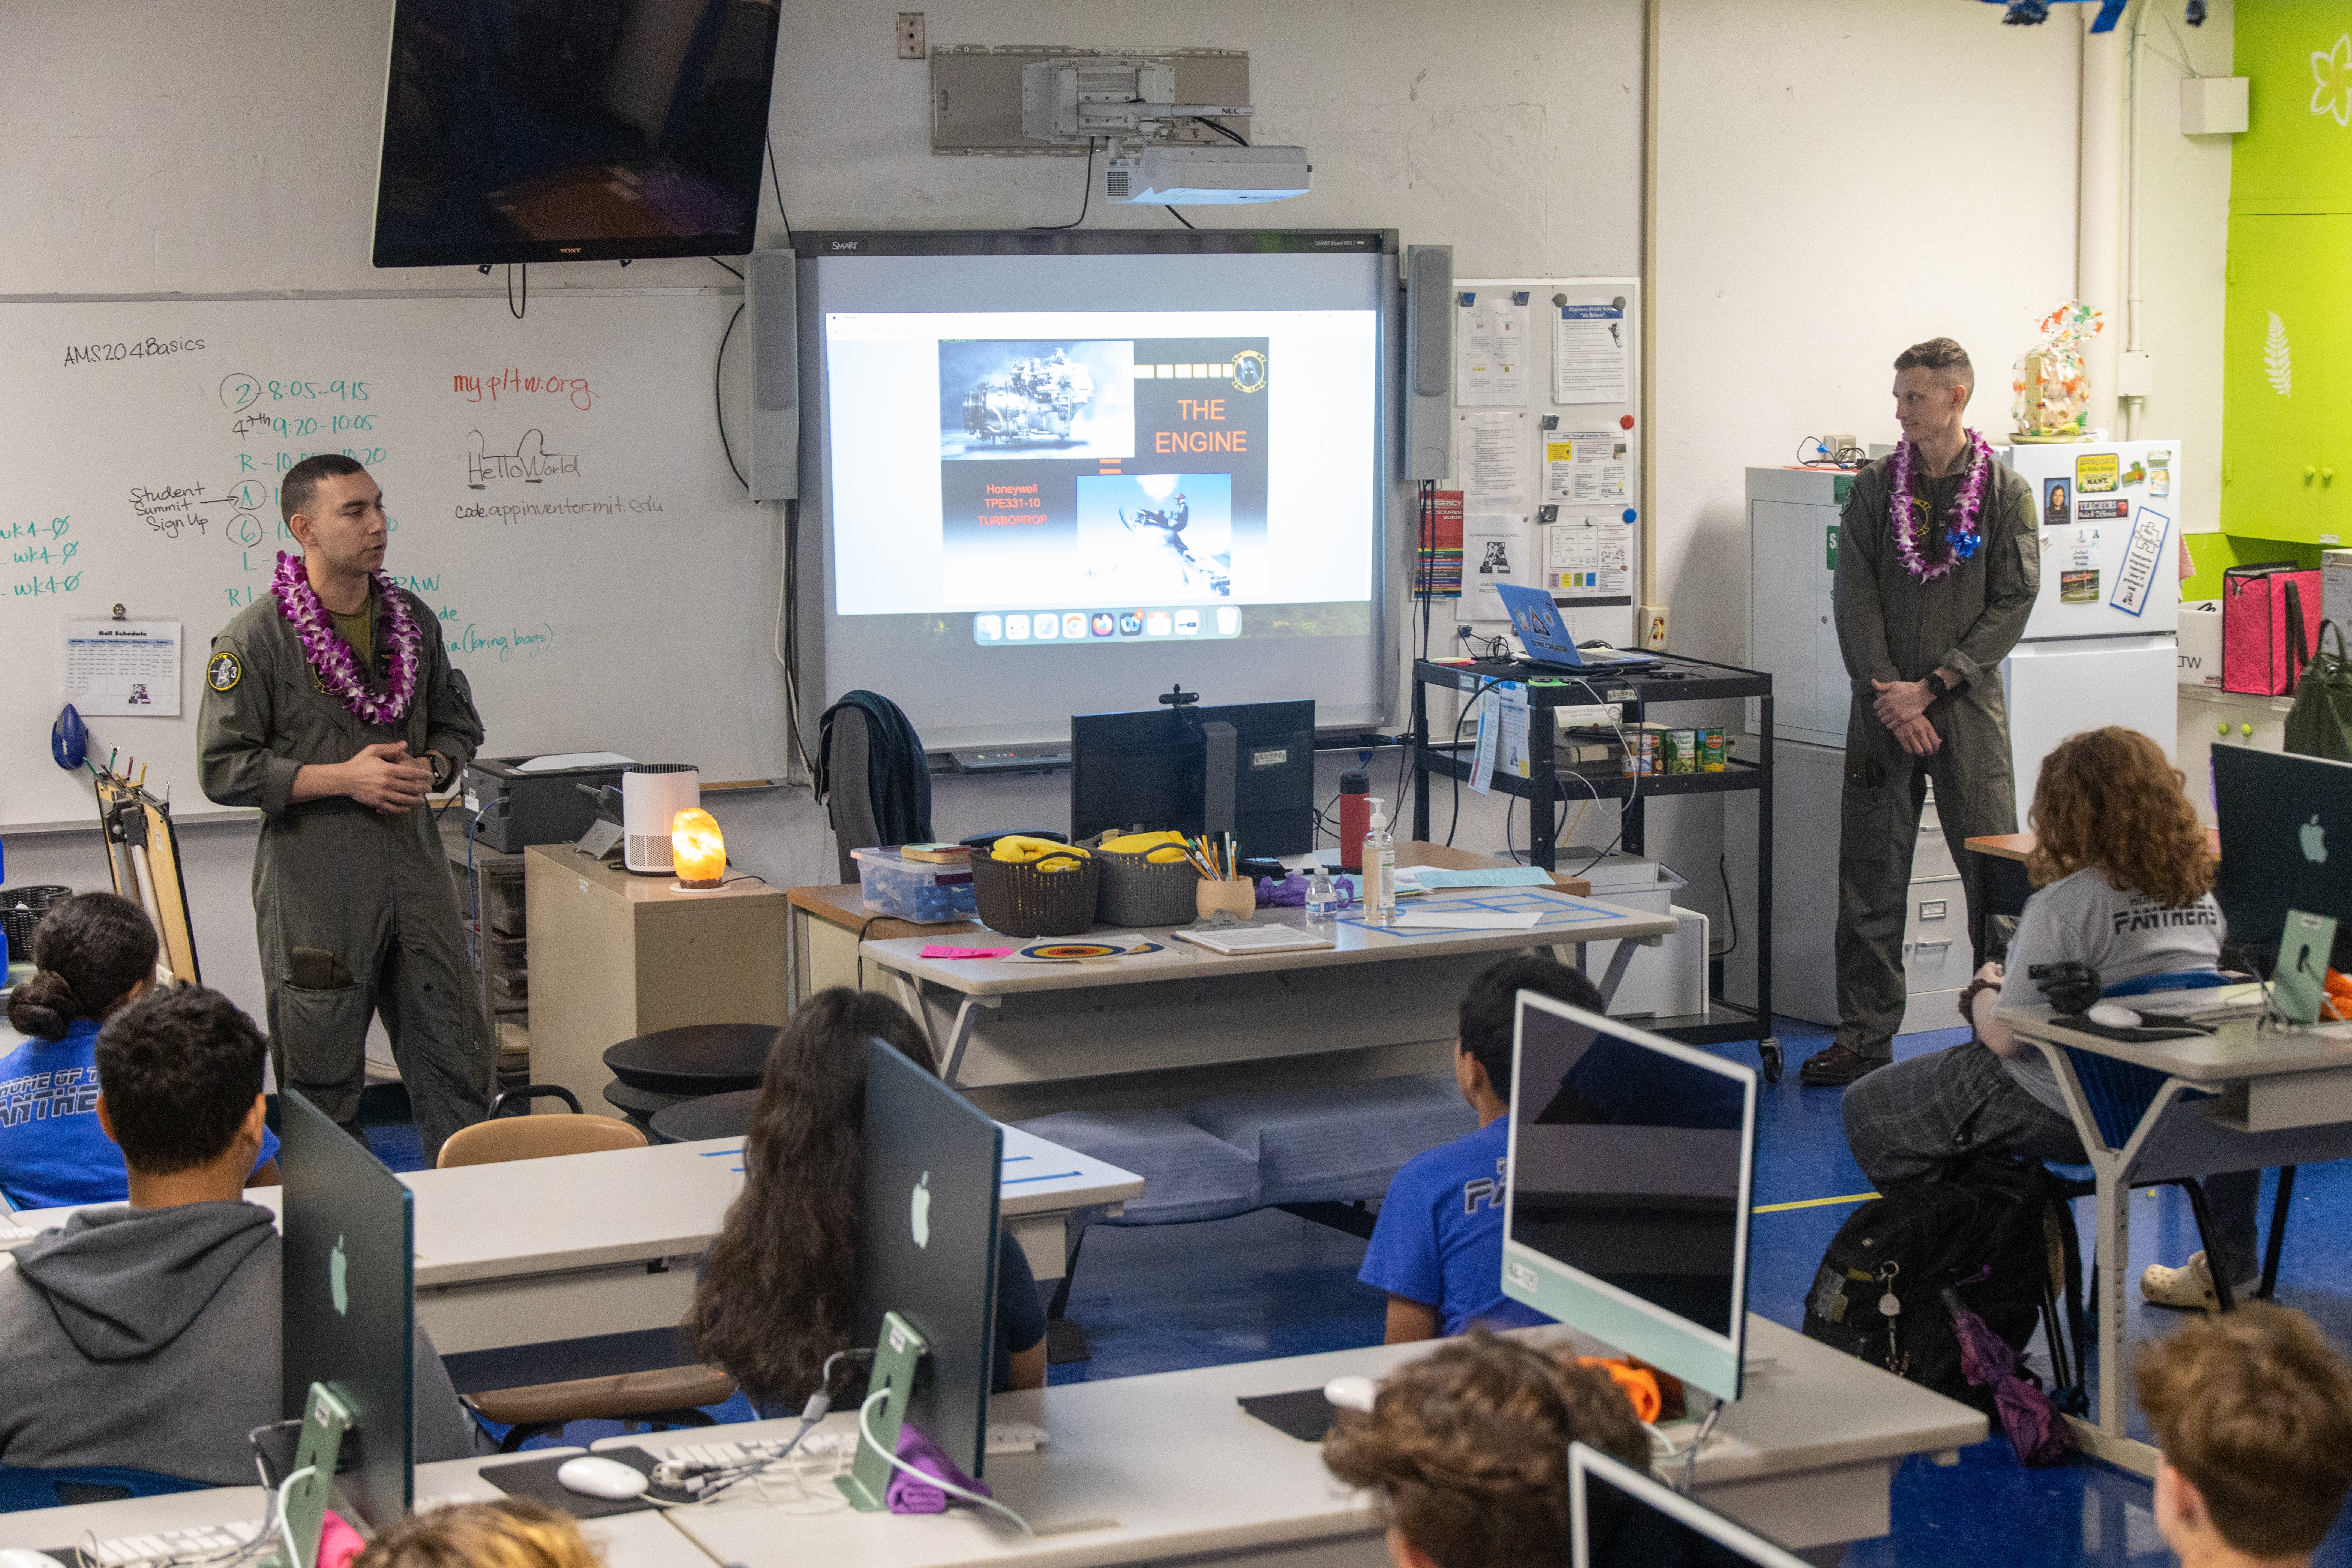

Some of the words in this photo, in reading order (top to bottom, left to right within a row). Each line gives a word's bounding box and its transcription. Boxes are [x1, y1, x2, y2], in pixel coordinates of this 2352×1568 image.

[832, 242, 859, 250] SMART
[1177, 399, 1225, 421] THE
[1155, 431, 1247, 453] ENGINE
[129, 482, 205, 503] Student
[986, 484, 1038, 496] Honeywell
[134, 499, 193, 516] Summit
[984, 498, 1040, 509] TPE331-10
[2078, 501, 2117, 510] TEACHERS
[146, 517, 184, 538] Sign
[184, 514, 209, 534] Up
[977, 514, 1048, 526] TURBOPROP
[230, 667, 237, 678] 3
[0, 1072, 52, 1098] HOME
[55, 1067, 84, 1087] OF
